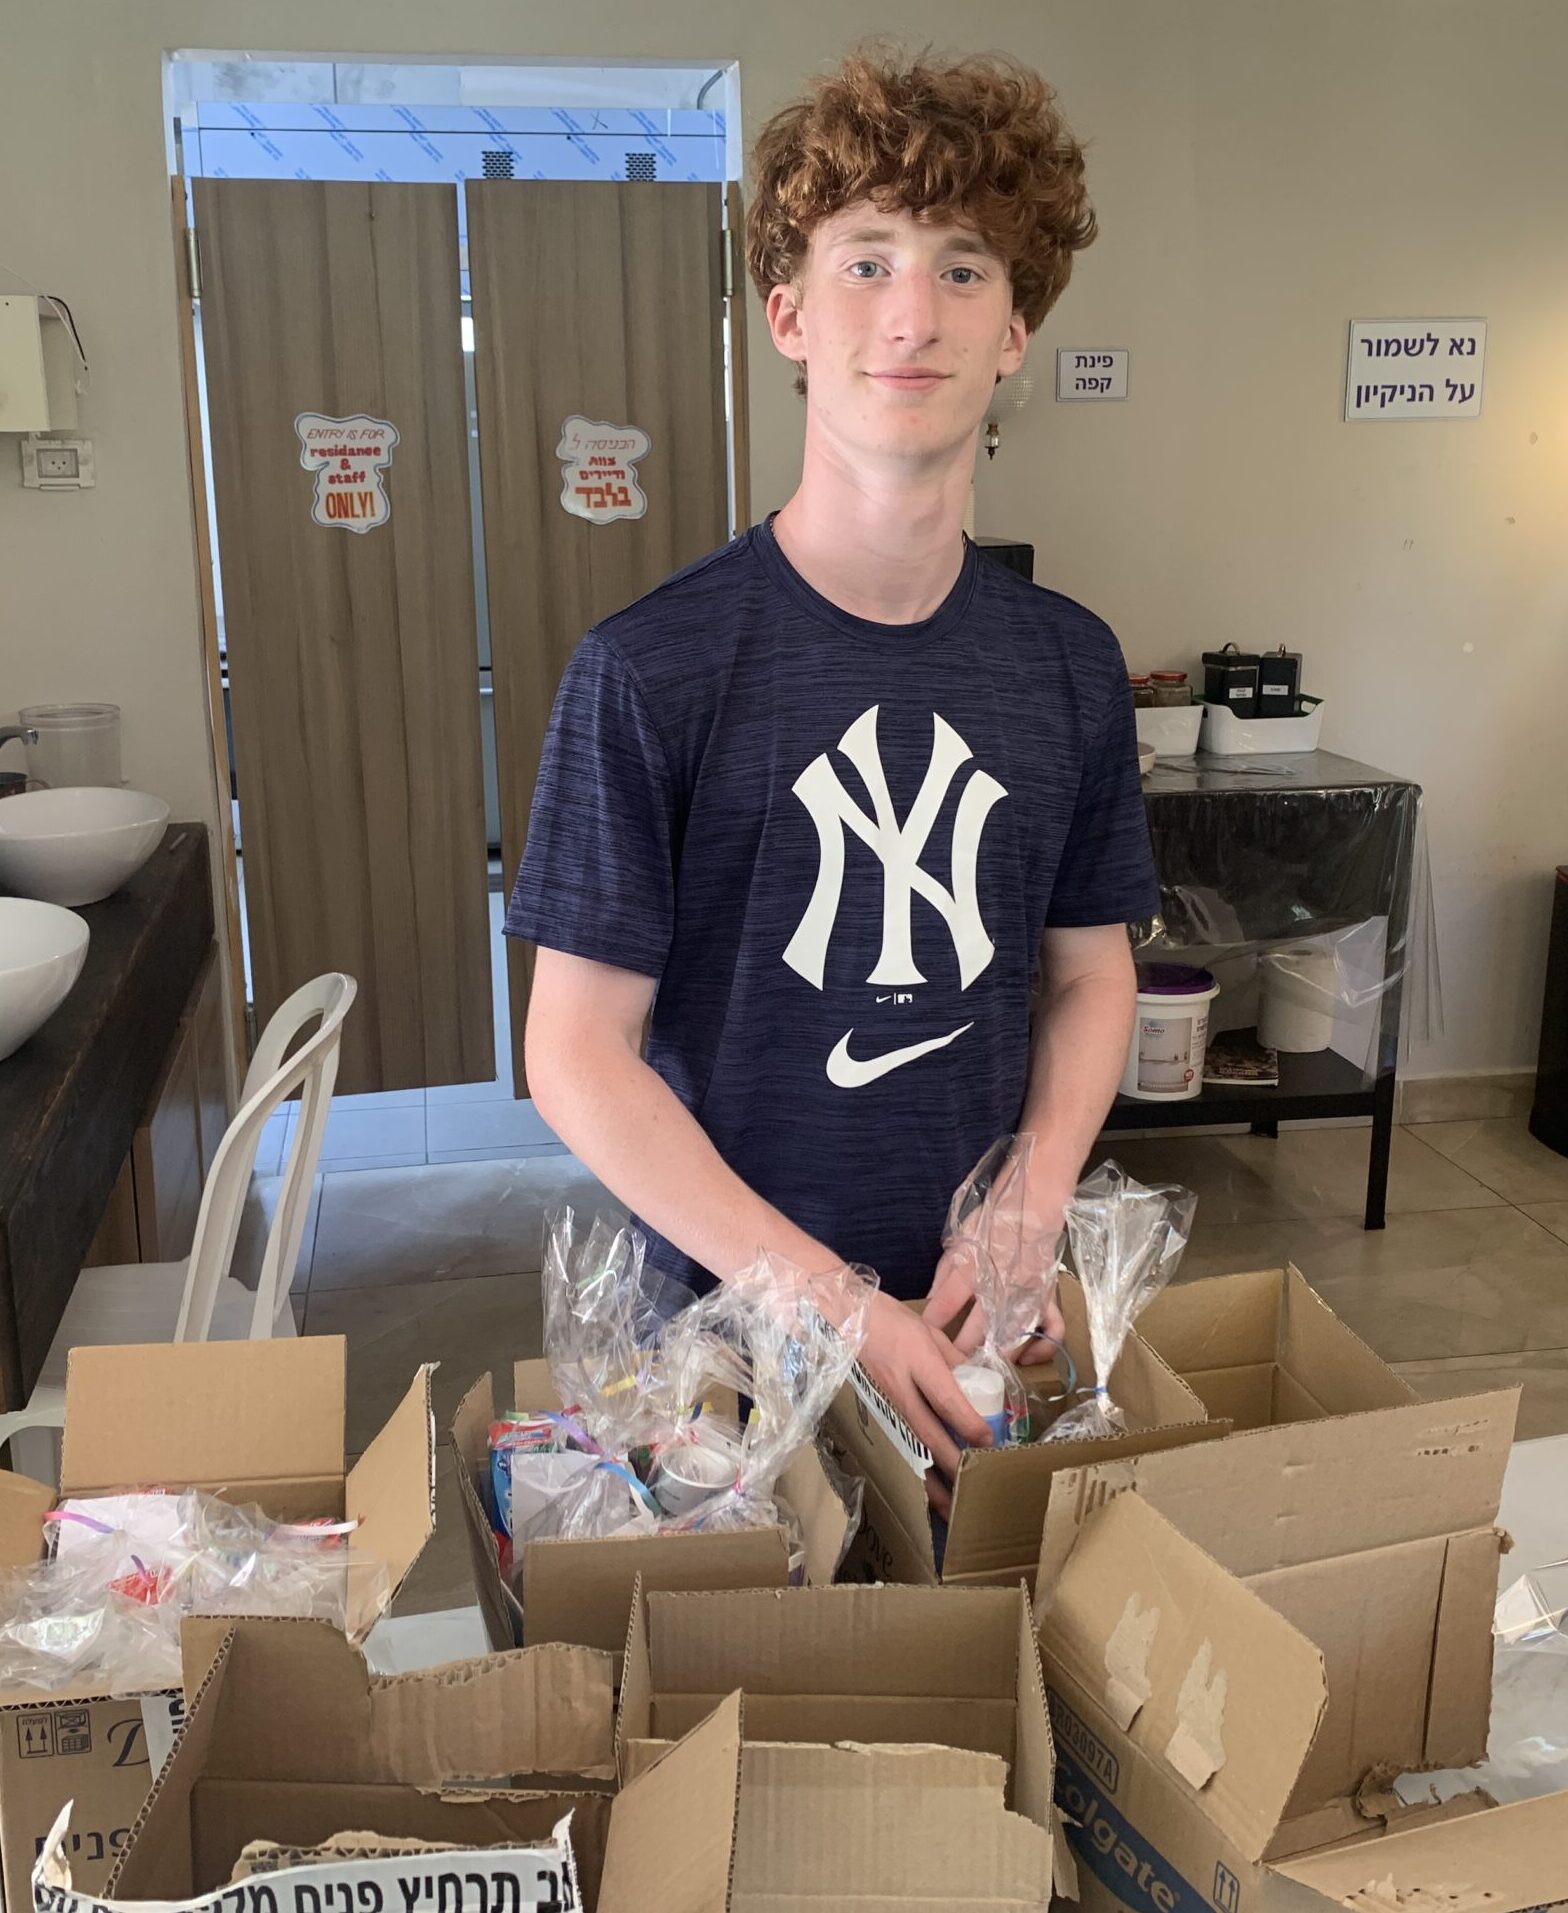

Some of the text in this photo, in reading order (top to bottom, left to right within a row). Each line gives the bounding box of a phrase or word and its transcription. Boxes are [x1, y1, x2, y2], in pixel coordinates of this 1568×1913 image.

[1360, 332, 1476, 357] נא לשמור
[1075, 355, 1114, 368] פינת
[1075, 377, 1112, 393] קפה
[1356, 378, 1475, 408] על הניקיון
[307, 428, 385, 440] ENTRY IS FOR
[340, 458, 351, 470] &
[328, 471, 366, 485] staff
[575, 482, 632, 508] בלבד
[325, 491, 376, 519] ONLY!
